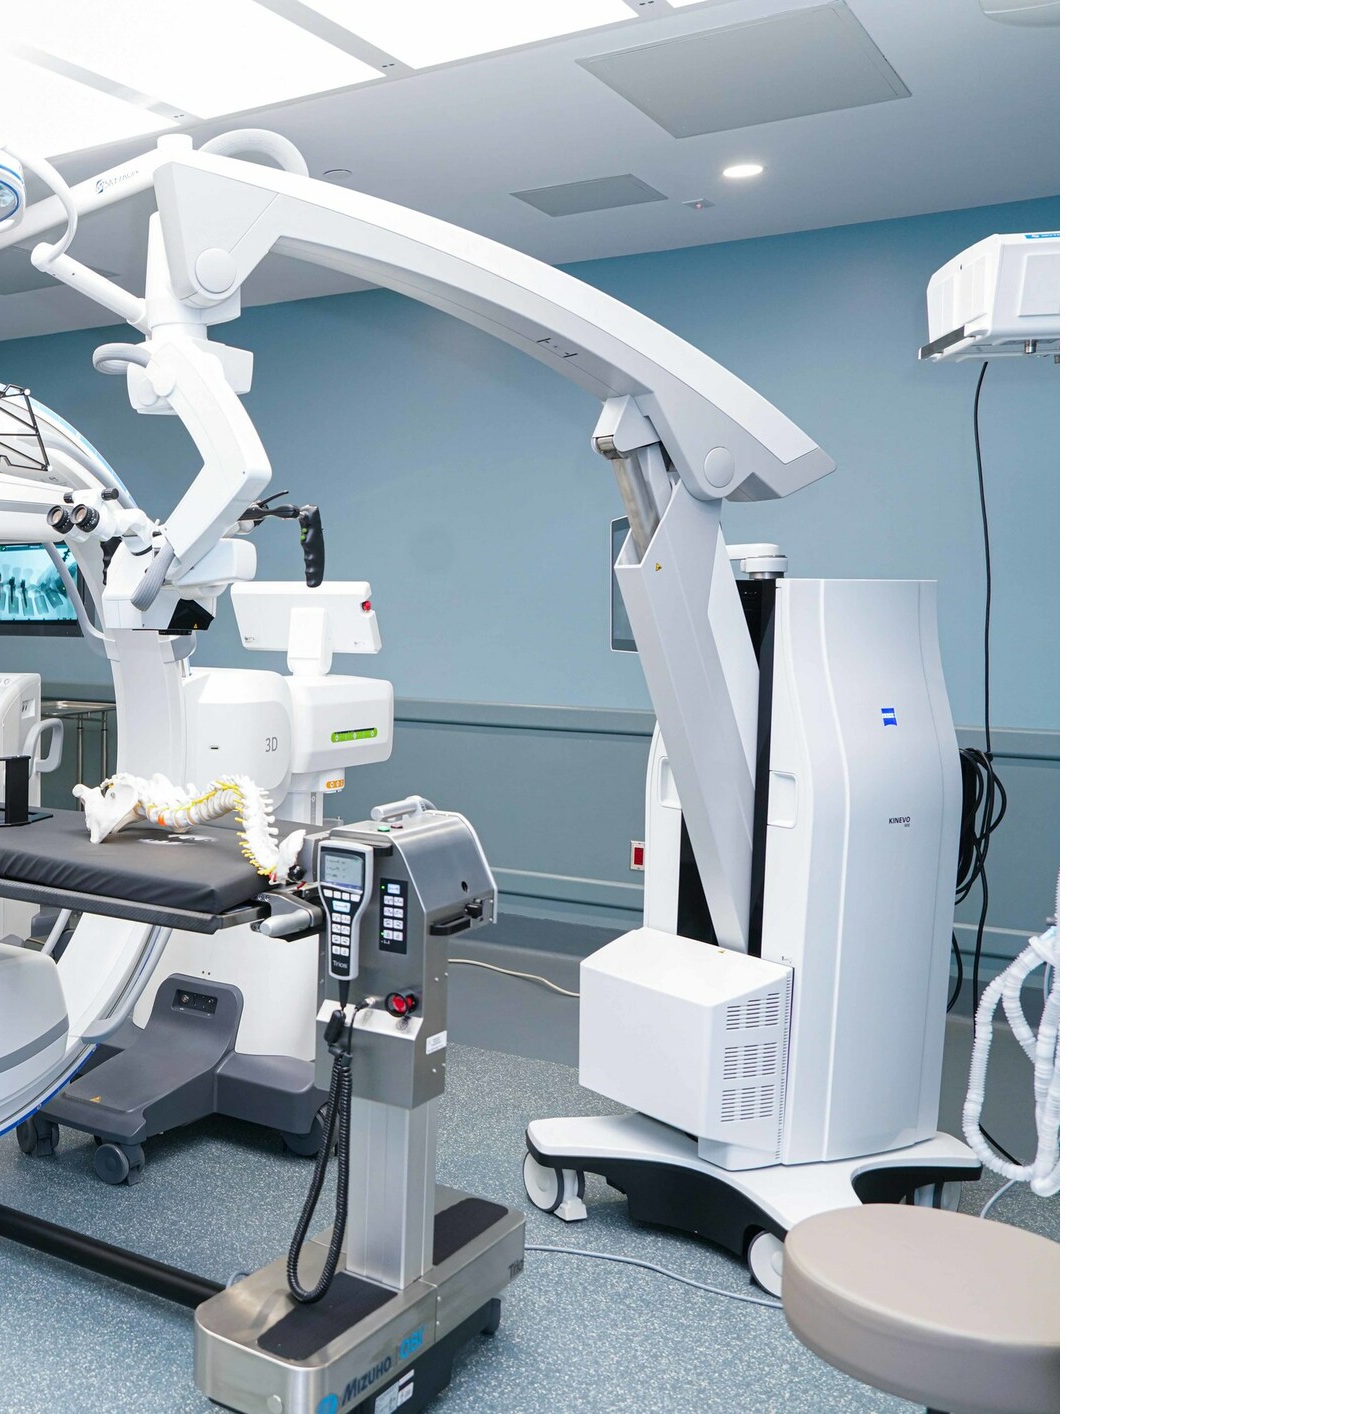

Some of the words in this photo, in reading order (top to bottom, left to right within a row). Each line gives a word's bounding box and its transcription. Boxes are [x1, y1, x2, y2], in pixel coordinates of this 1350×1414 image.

[265, 736, 278, 752] 3D
[888, 816, 911, 824] KINEVO
[332, 959, 348, 969] Trios
[342, 1356, 392, 1407] MIZUHO
